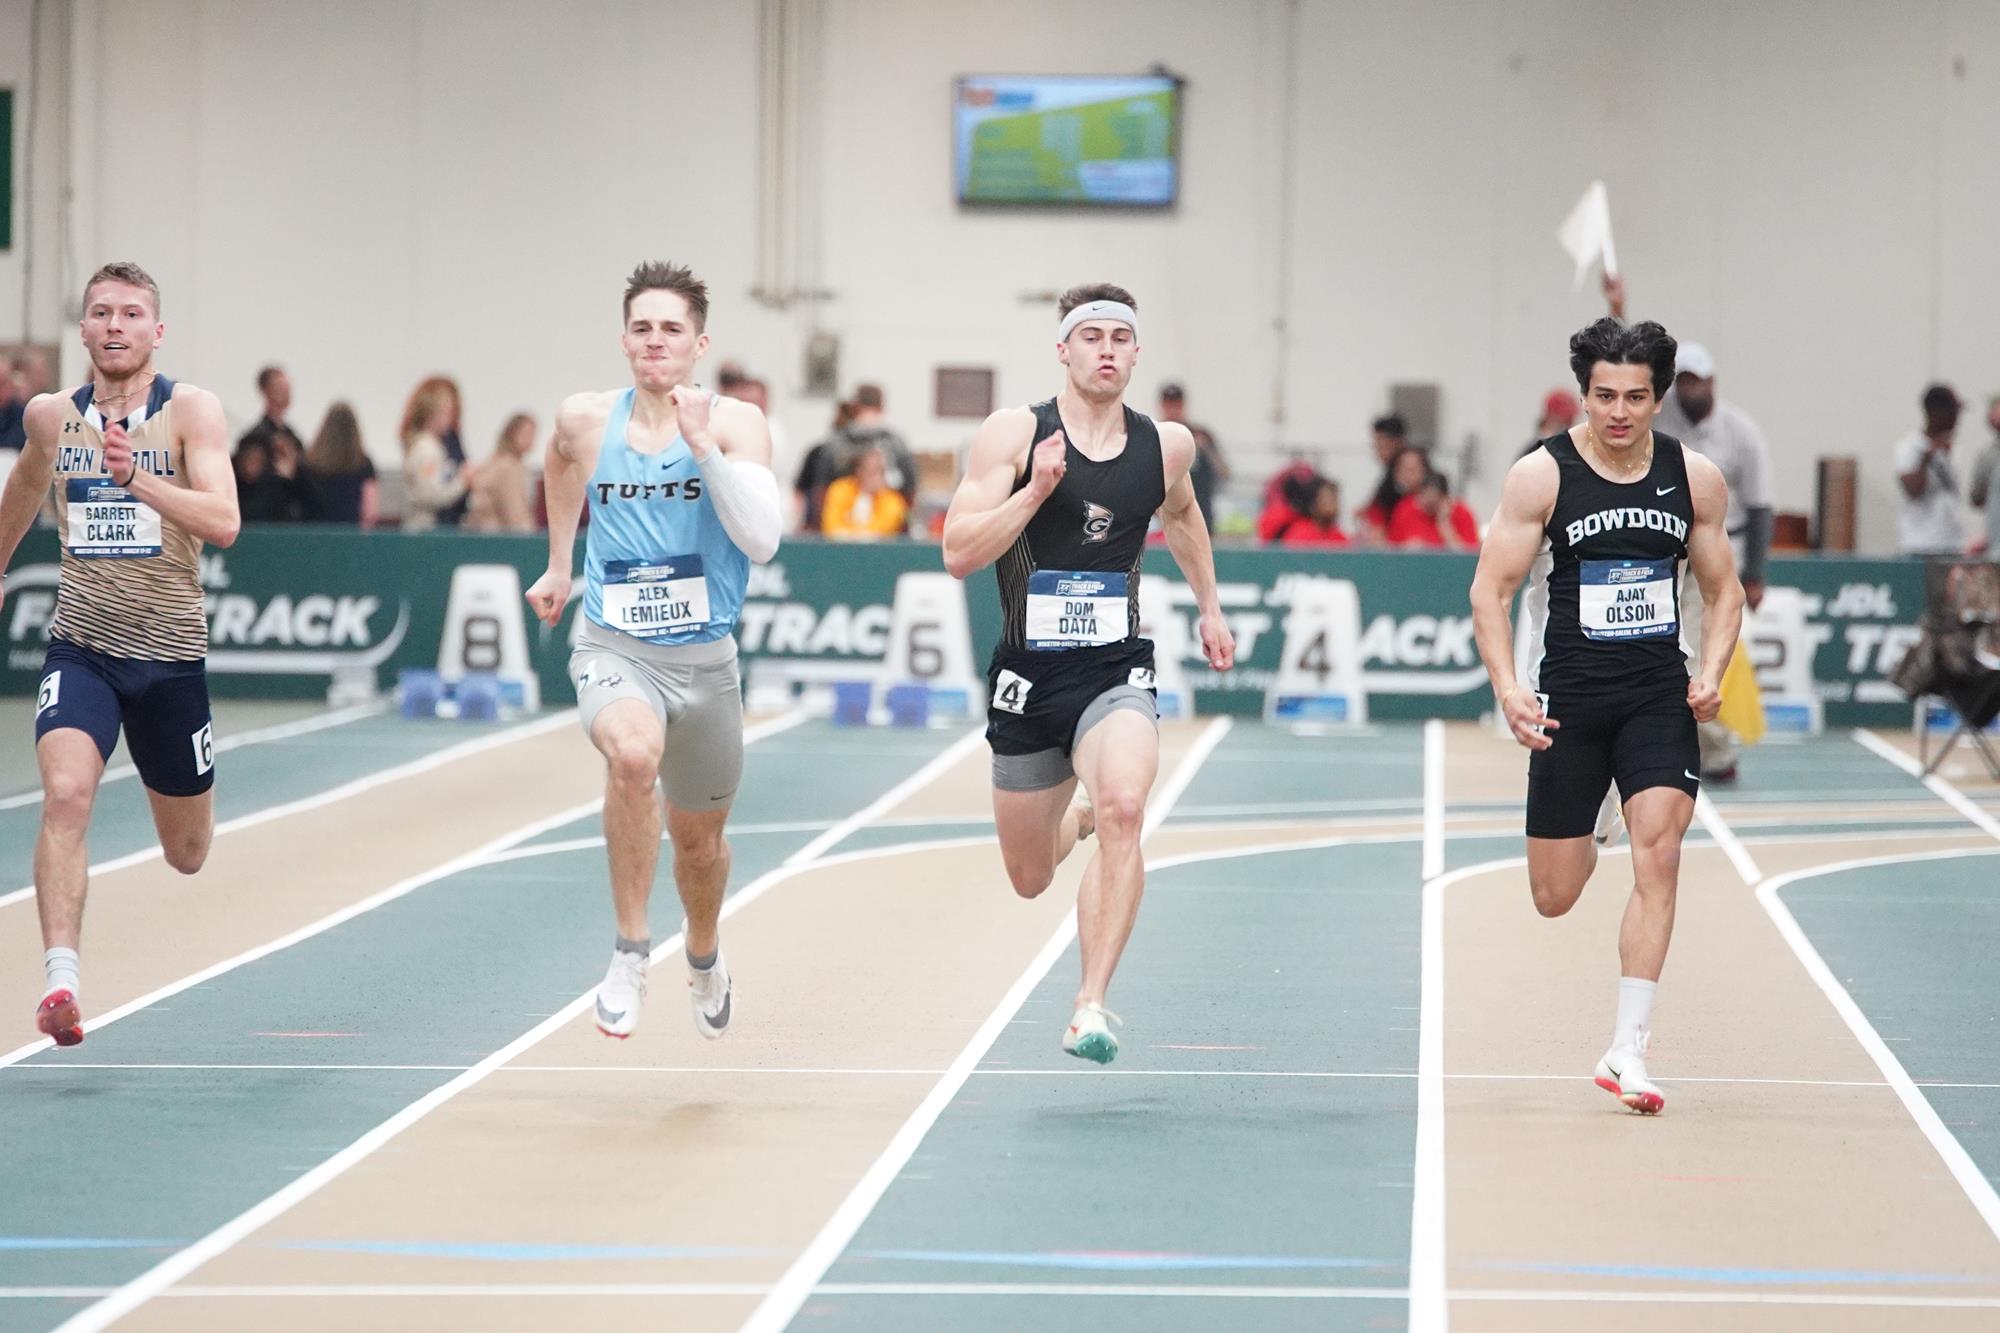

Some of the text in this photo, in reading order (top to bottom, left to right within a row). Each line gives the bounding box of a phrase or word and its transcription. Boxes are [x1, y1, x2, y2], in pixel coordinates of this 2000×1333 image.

[56, 446, 95, 472] JOHN
[597, 478, 702, 505] TUFTS
[85, 506, 136, 521] GARRETT
[87, 524, 136, 541] CLARK
[1565, 507, 1688, 547] BOWDOIN
[638, 586, 670, 602] ALEX
[1616, 588, 1646, 603] AJAY
[622, 601, 692, 623] LEMIEUX
[1065, 601, 1094, 616] DOM
[1606, 603, 1655, 624] OLSON
[739, 601, 892, 655] TRAC
[1058, 618, 1098, 635] DATA
[463, 615, 501, 671] 8
[909, 621, 944, 677] 6
[1298, 629, 1331, 682] 4
[1000, 679, 1021, 710] 4
[201, 728, 212, 767] 6
